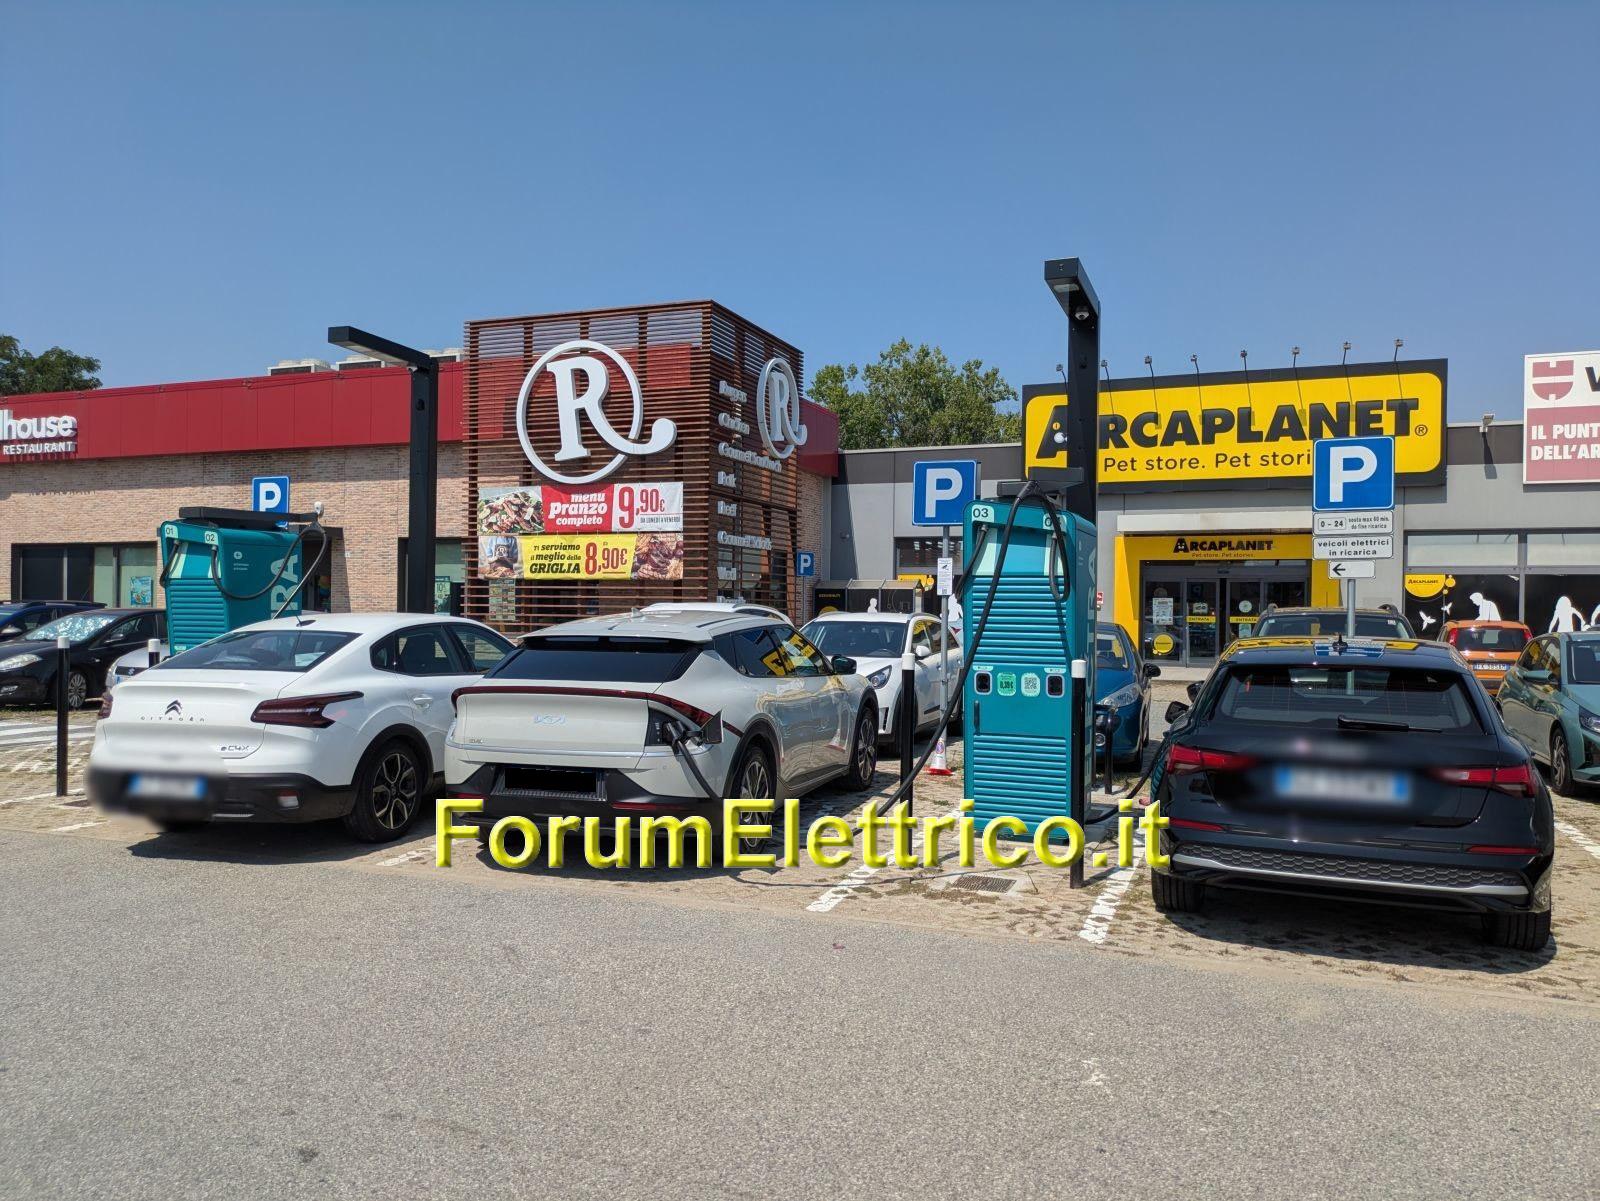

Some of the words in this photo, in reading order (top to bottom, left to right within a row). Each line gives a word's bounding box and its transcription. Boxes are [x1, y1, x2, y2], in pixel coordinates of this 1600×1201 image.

[547, 356, 677, 462] R
[1531, 425, 1547, 440] IL
[1552, 422, 1600, 439] PUNT
[3, 441, 75, 455] RESTAURANT
[1530, 443, 1600, 460] DELL'AR
[1104, 457, 1137, 473] Pet
[1145, 456, 1205, 471] store.
[1215, 452, 1250, 468] Pet
[1259, 449, 1311, 467] stori
[1329, 445, 1378, 503] P
[259, 482, 282, 512] P
[571, 492, 606, 503] menu
[925, 468, 963, 518] P
[972, 508, 989, 518] 03
[556, 515, 603, 527] completo
[1334, 520, 1344, 528] 24
[165, 527, 175, 536] 01
[205, 533, 215, 542] 02
[540, 543, 580, 551] serviamo
[1173, 538, 1274, 553] ARCAPLANET
[1350, 538, 1390, 546] elettrici
[535, 551, 566, 562] meglio
[1340, 548, 1377, 556] ricarica
[529, 562, 581, 574] GRIGLIA
[800, 553, 811, 574] P
